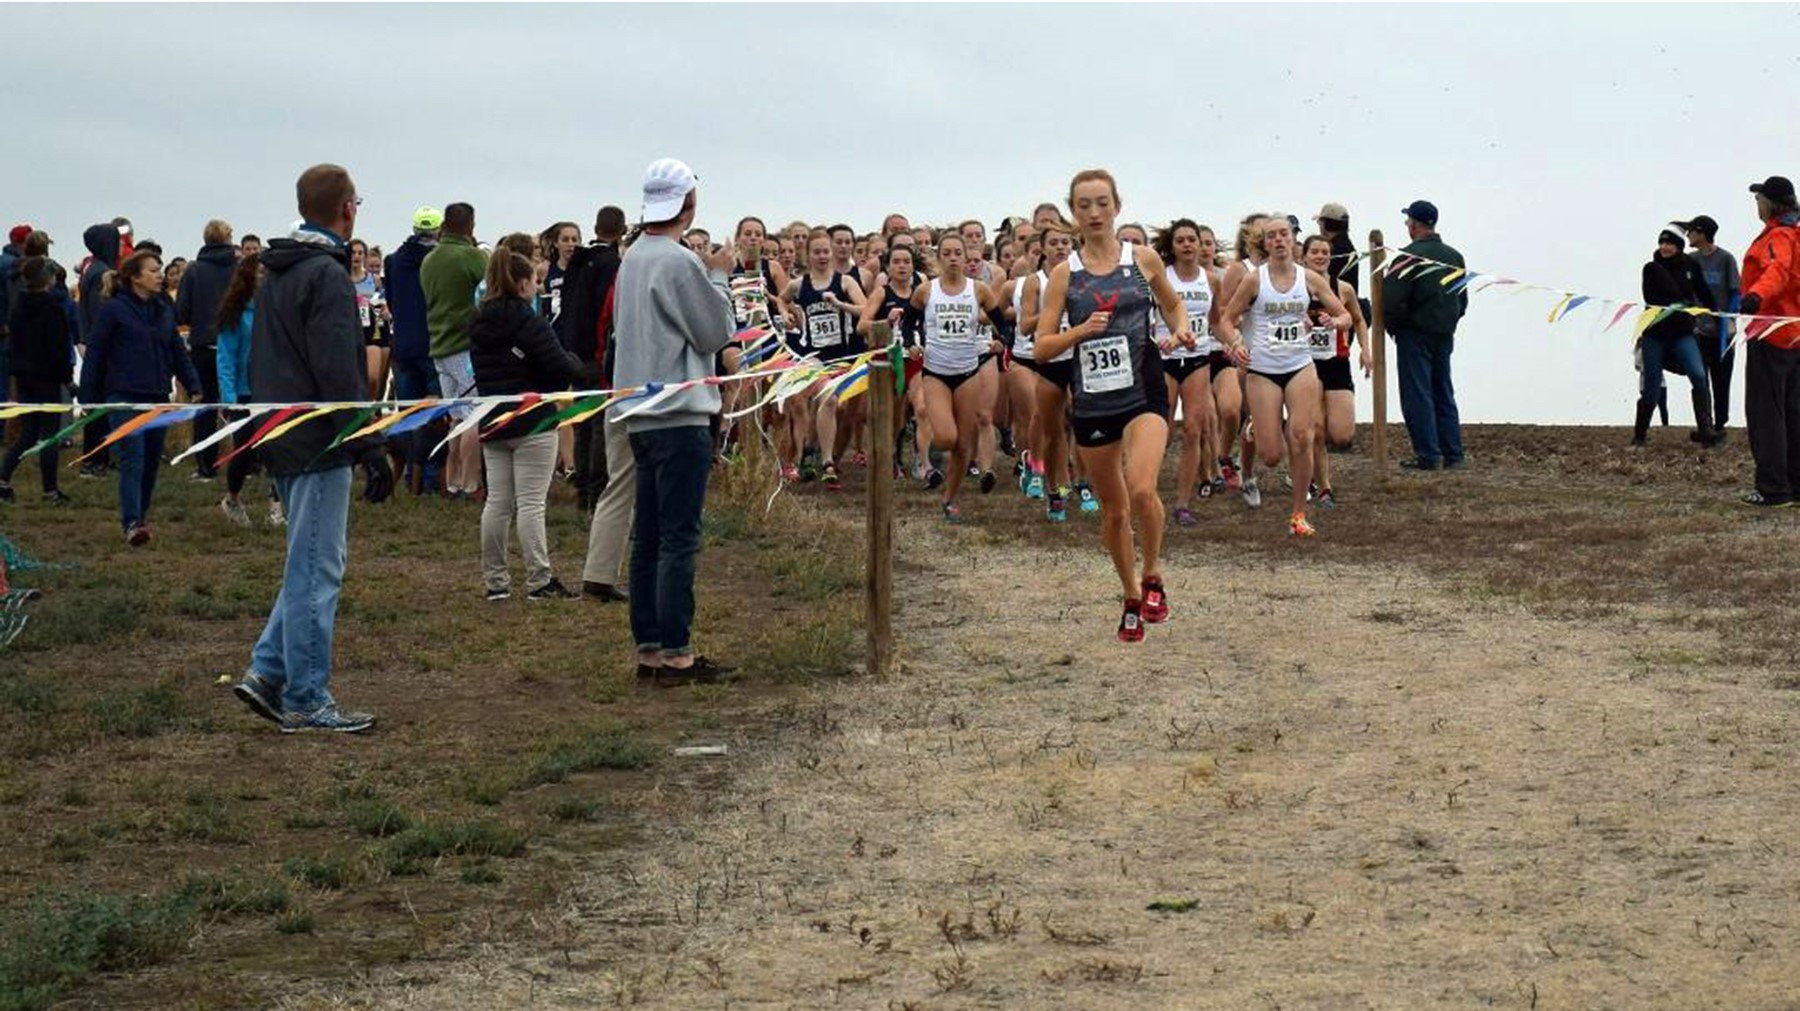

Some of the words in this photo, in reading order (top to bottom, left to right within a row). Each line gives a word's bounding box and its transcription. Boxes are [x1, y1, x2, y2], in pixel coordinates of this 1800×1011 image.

[935, 303, 973, 313] IDAHO
[1265, 302, 1304, 314] IDAHO
[814, 320, 835, 334] 361
[943, 319, 966, 333] 412
[1274, 326, 1298, 341] 419
[1088, 348, 1121, 371] 338
